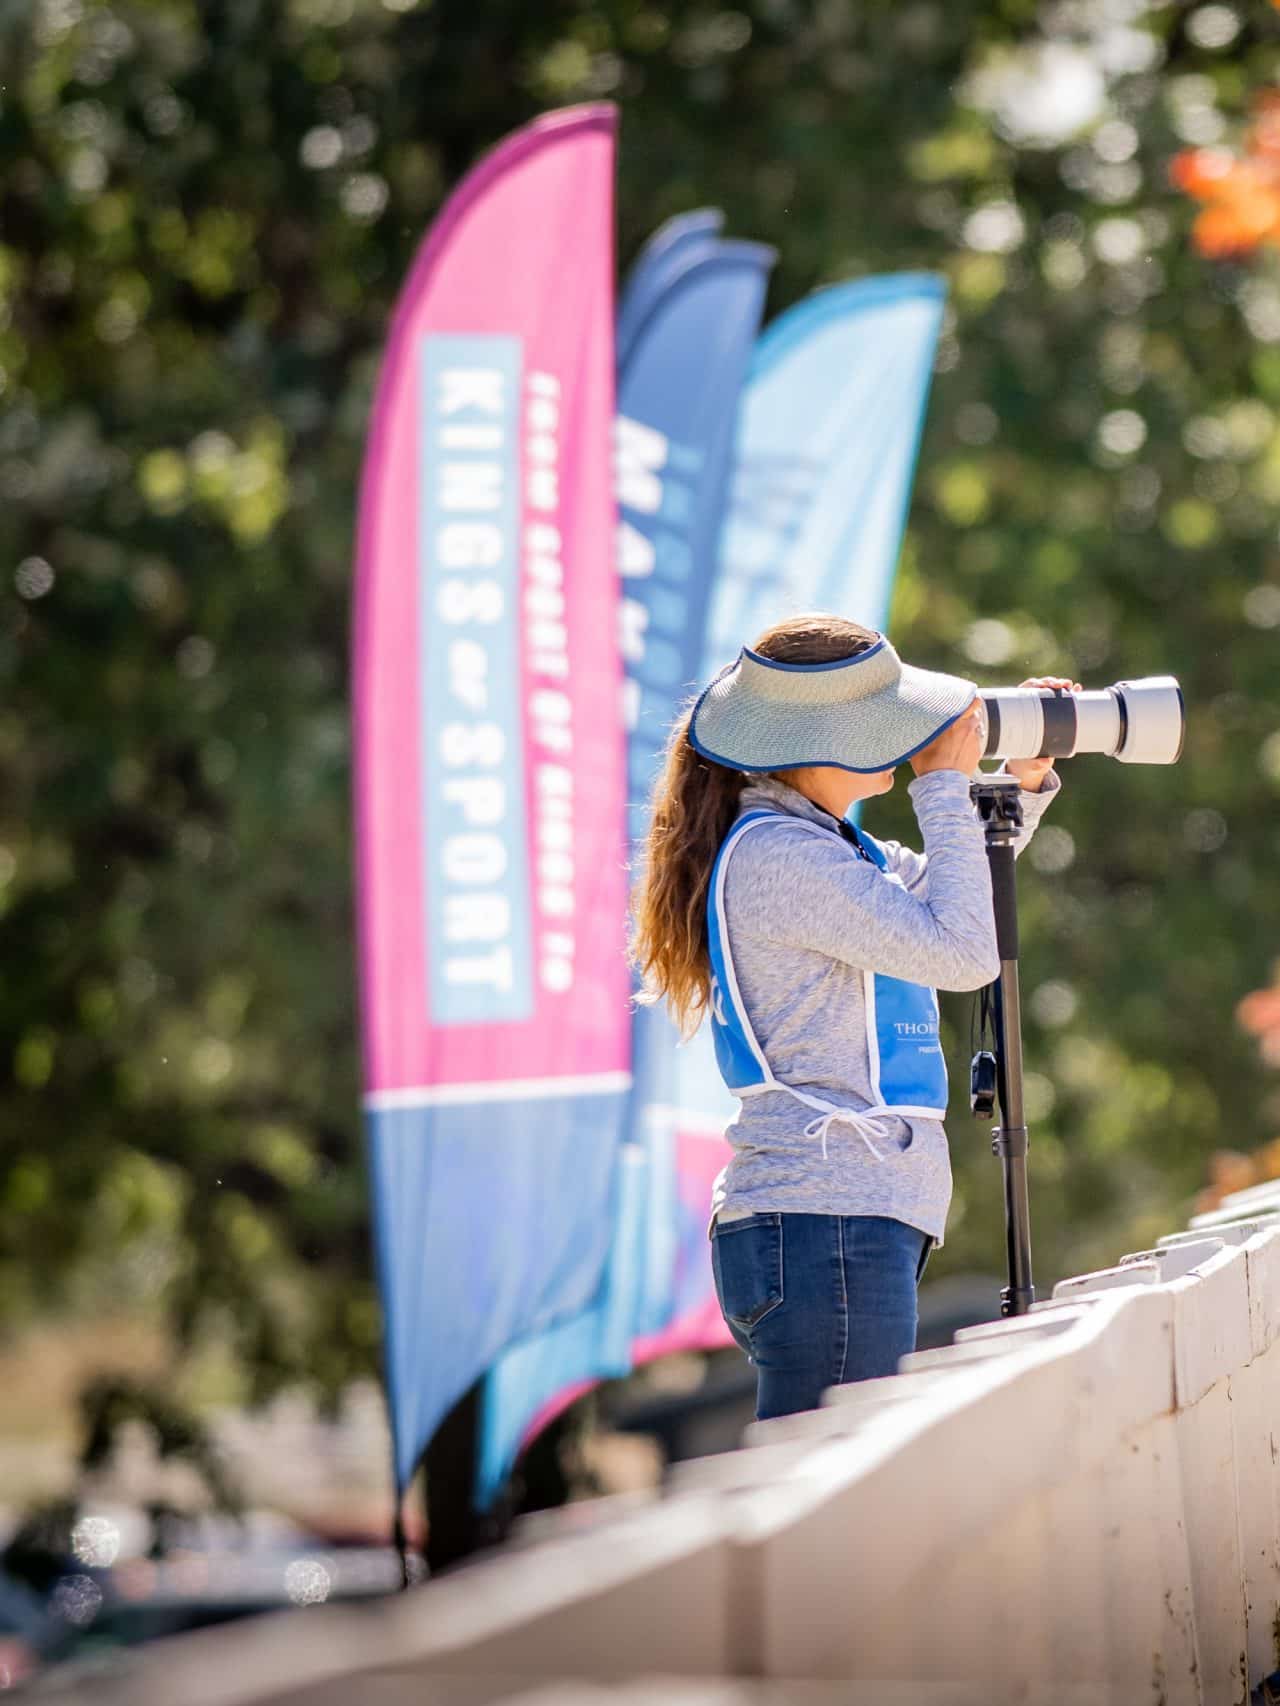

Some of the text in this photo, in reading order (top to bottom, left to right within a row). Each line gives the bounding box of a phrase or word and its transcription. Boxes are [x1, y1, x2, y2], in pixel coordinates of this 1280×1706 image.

[437, 368, 504, 625] KINGS
[530, 690, 574, 753] OF
[440, 721, 514, 993] SPORT
